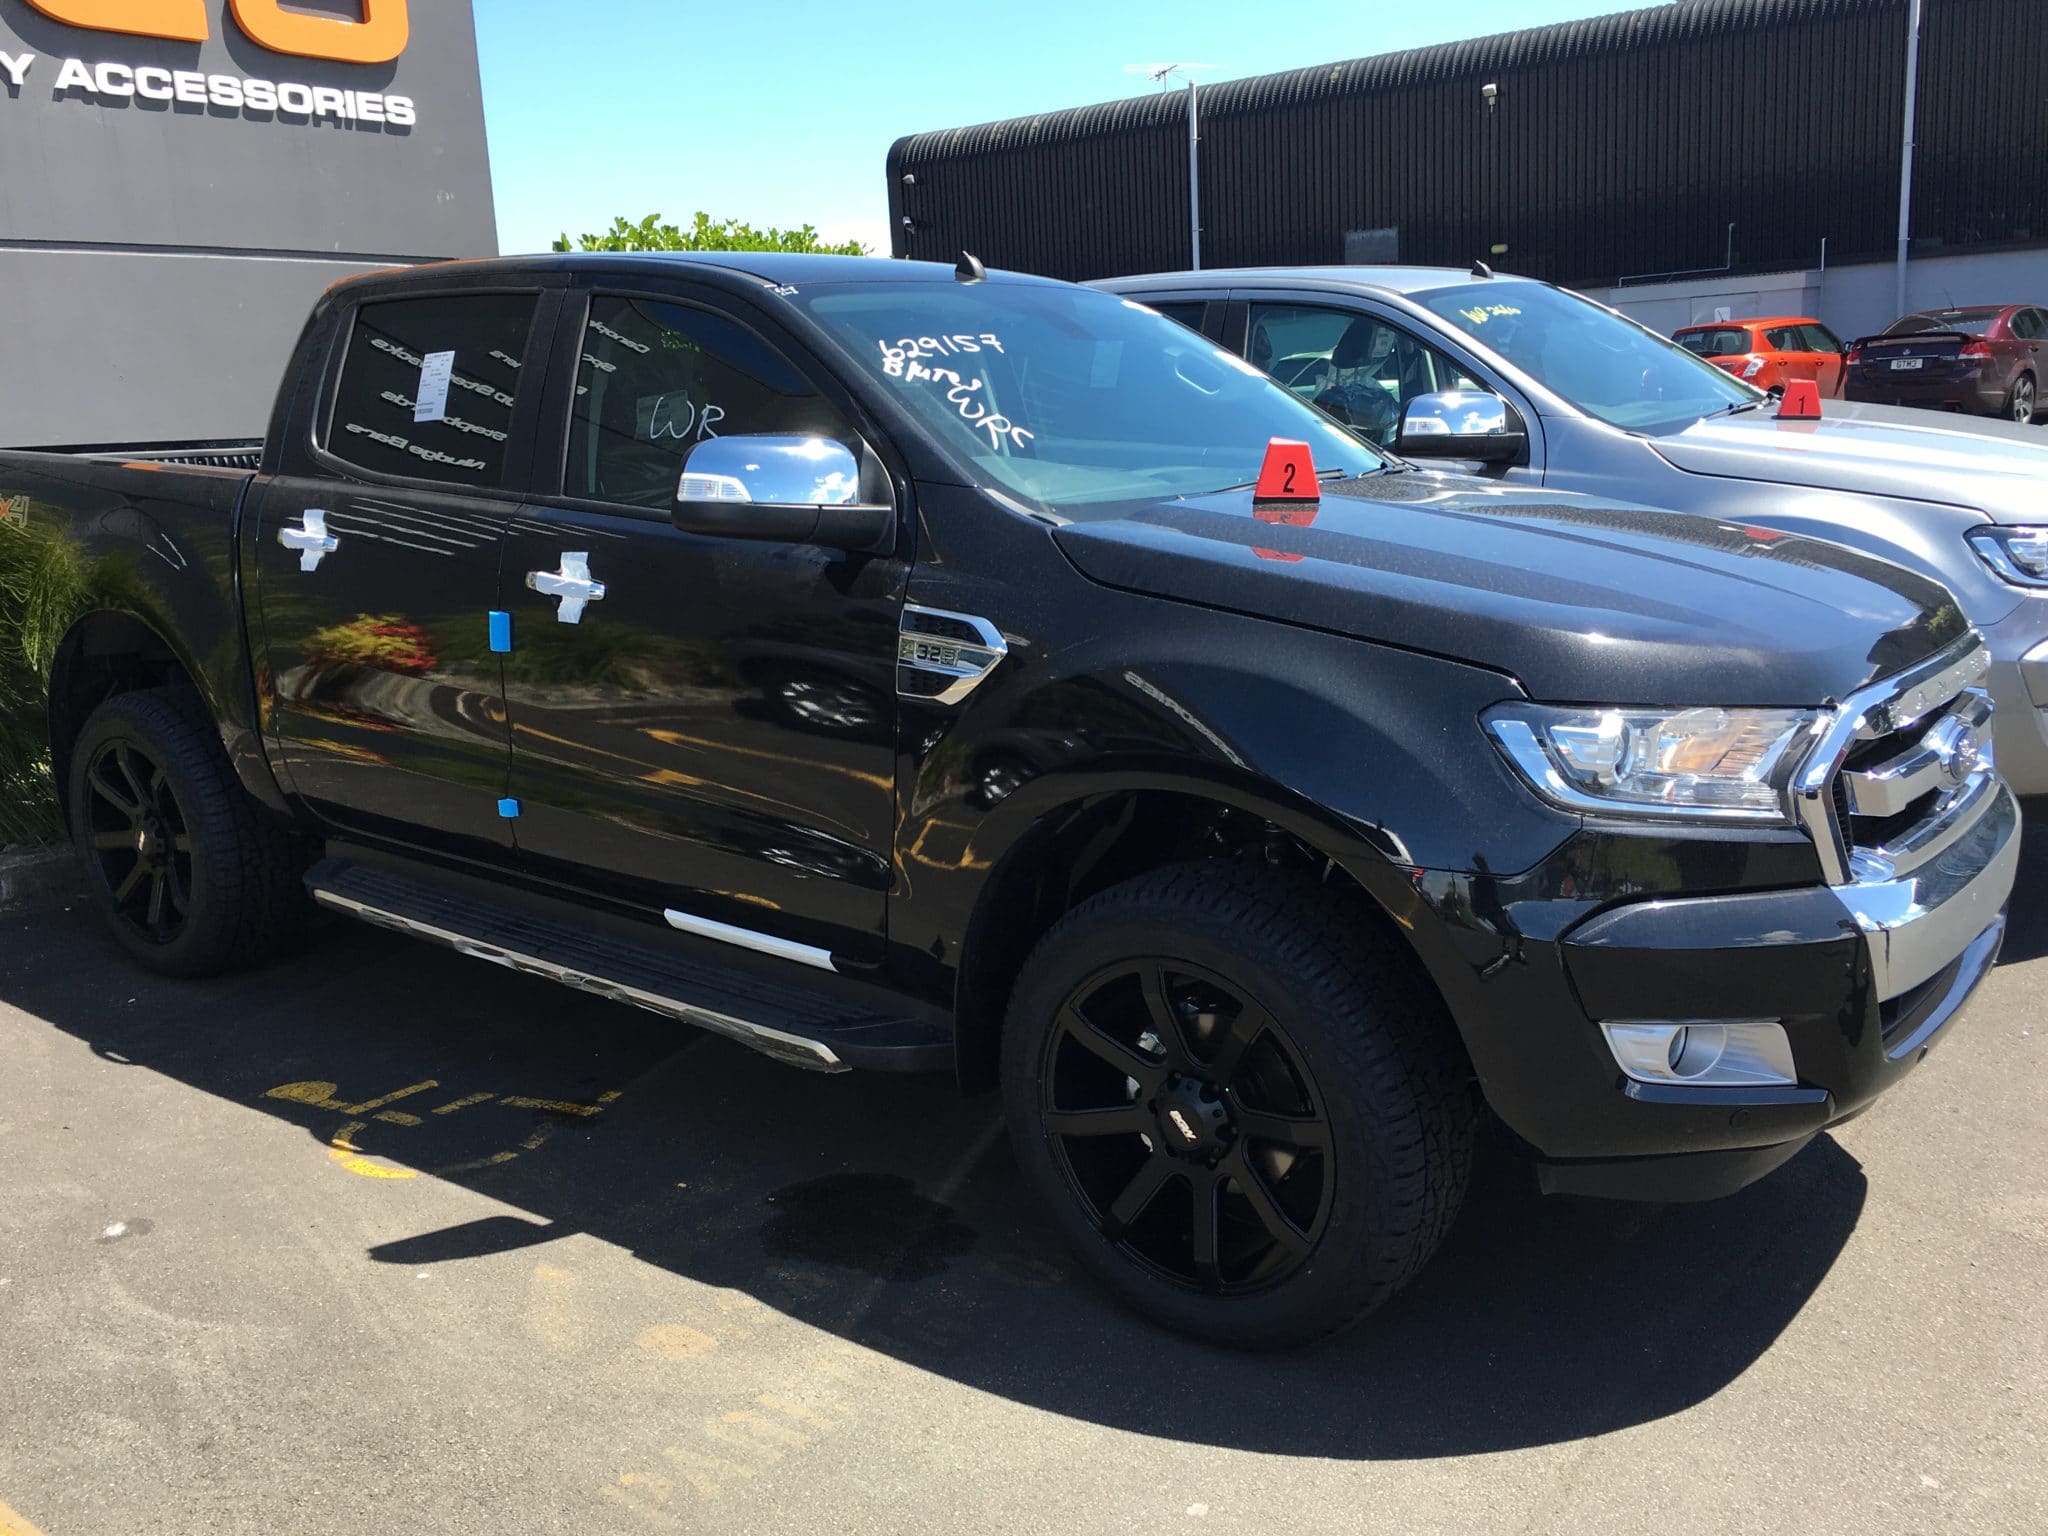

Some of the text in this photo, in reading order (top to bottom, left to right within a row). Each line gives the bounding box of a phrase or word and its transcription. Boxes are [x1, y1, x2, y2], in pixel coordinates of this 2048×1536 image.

[54, 58, 416, 126] ACCESSORIES
[650, 396, 725, 440] WR
[1799, 395, 1805, 414] 1
[1283, 463, 1296, 493] 2
